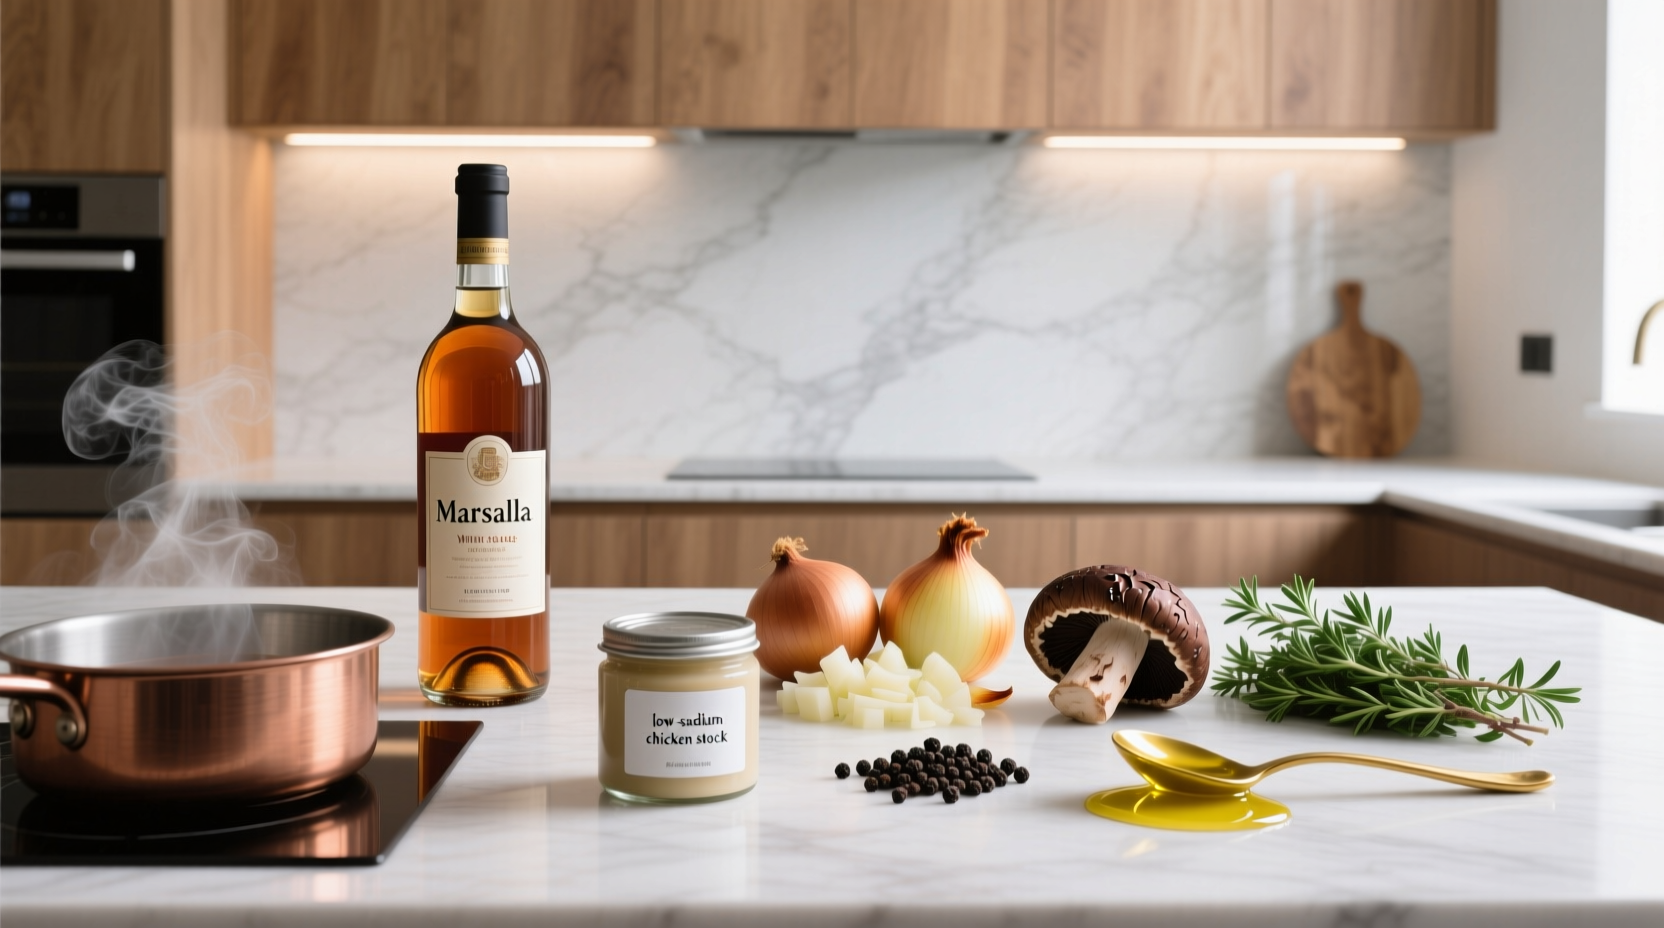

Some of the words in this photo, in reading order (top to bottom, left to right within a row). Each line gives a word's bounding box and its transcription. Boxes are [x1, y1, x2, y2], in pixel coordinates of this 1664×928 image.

[436, 498, 532, 523] Marsalla
[652, 712, 675, 728] low
[646, 731, 692, 745] chicken
[696, 730, 728, 745] stock
